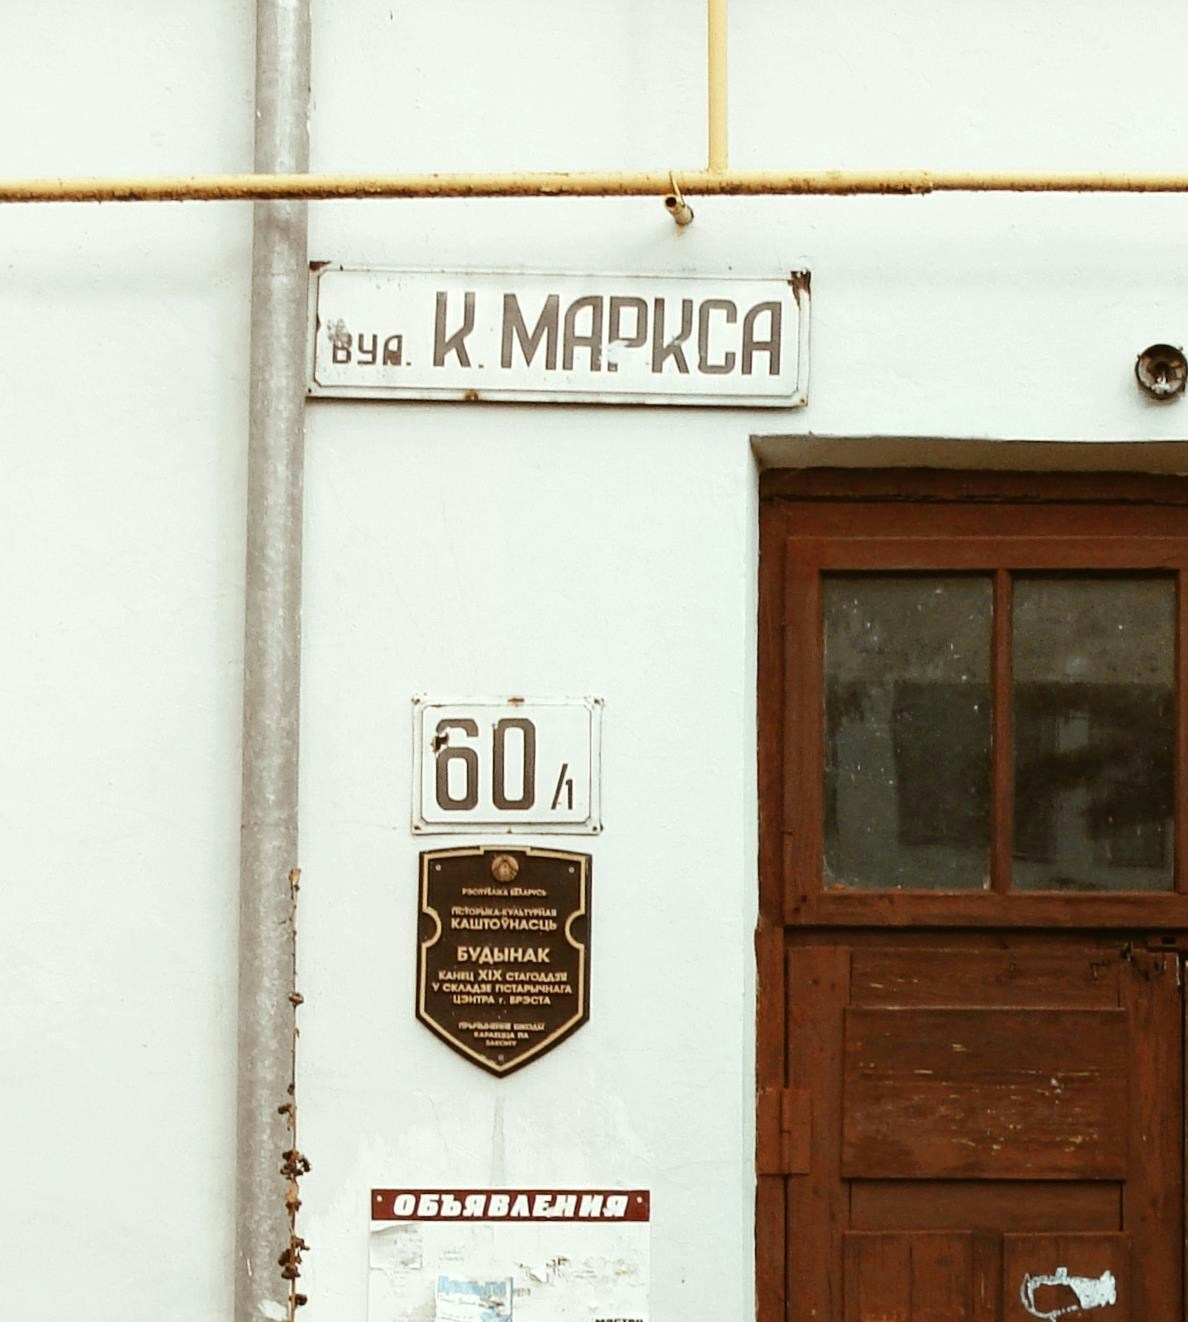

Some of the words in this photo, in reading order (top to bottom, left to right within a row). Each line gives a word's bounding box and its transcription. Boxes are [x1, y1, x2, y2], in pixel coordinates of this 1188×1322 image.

[433, 291, 484, 369] К.
[500, 293, 782, 375] МАРКСА
[451, 916, 557, 932] КАШТОЎНАСЦЬ
[457, 946, 550, 964] БУДЫНАК
[438, 970, 474, 982] КАНЕЦ
[442, 982, 492, 993] СКЛАДЗЕ
[453, 994, 495, 1005] ЦЭНТРА
[509, 995, 552, 1005] БРЭСТА
[393, 1193, 629, 1217] ОБЪЯВЛЕНИЯ
